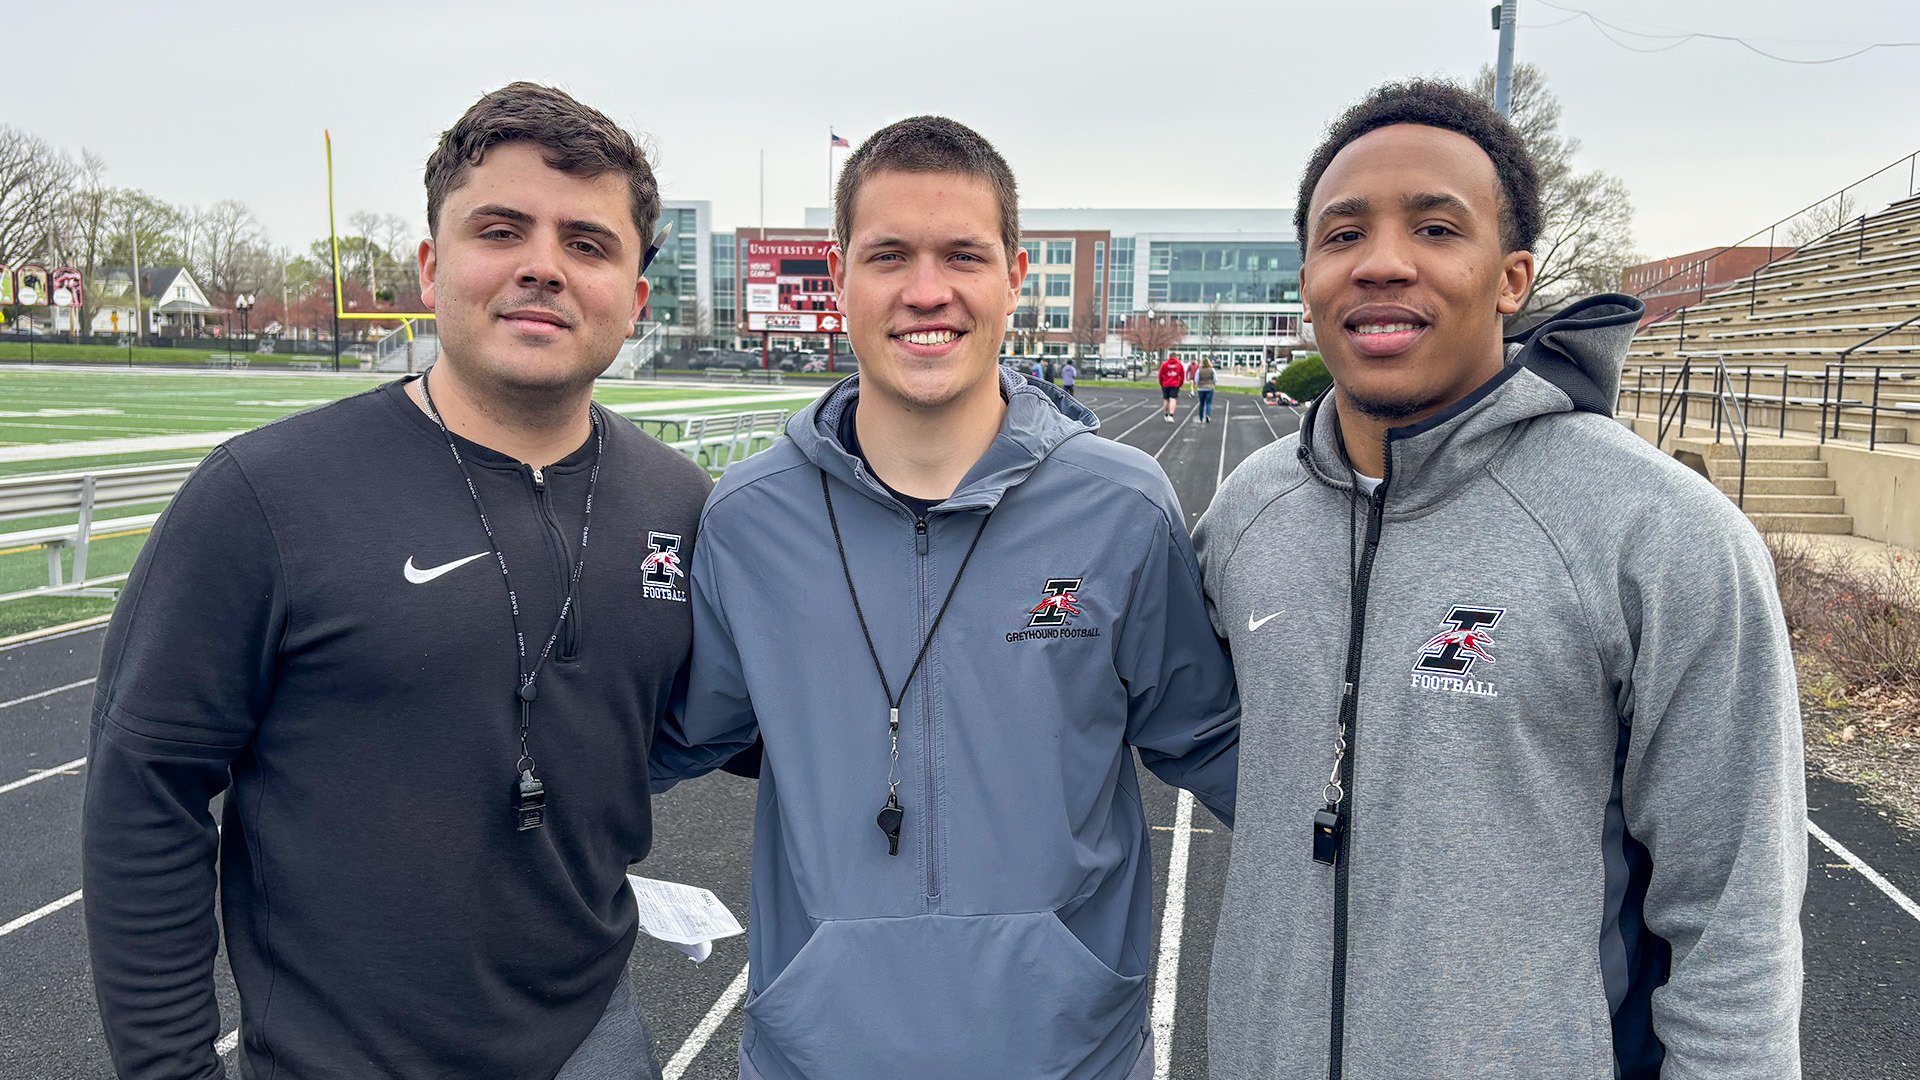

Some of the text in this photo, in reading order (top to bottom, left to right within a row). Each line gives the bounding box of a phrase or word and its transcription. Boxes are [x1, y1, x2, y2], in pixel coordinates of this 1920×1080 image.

[749, 244, 814, 255] UNIVERSITY
[643, 586, 687, 602] FOOTBALL
[509, 590, 520, 616] FOX40
[1006, 627, 1100, 642] GREYHOUND FOOTBALL
[1410, 673, 1498, 697] FOOTBALL
